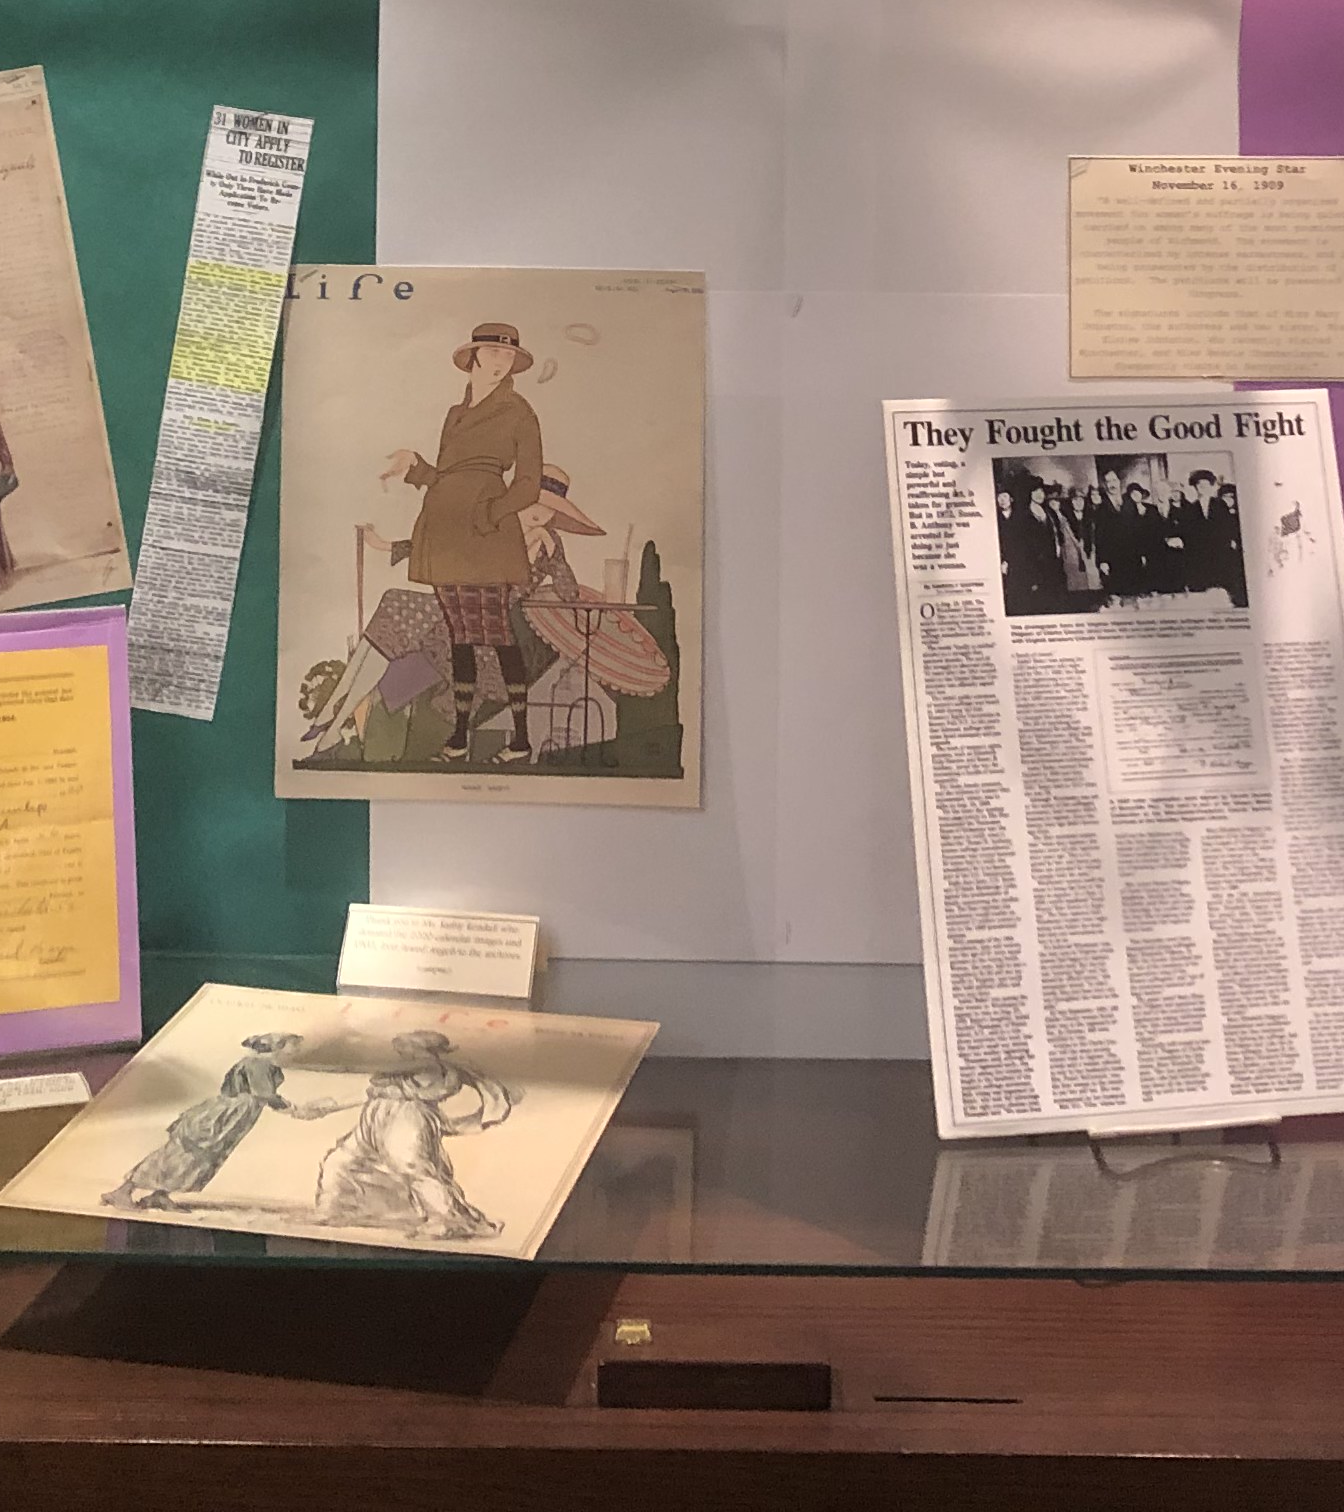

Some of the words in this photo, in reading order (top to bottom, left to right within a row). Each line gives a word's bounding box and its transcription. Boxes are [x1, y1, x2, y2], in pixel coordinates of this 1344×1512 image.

[214, 112, 226, 125] 31
[234, 114, 273, 132] WOMEN
[277, 120, 290, 135] IN
[226, 130, 251, 147] CITY
[255, 134, 290, 153] APPLY
[239, 150, 253, 164] TO
[254, 152, 305, 171] REGISTER
[1129, 164, 1206, 173] Winchester
[1214, 164, 1269, 175] Evening
[1276, 164, 1307, 174] Star
[903, 420, 974, 452] They
[986, 417, 1083, 450] Fought
[1095, 416, 1138, 441] the
[1149, 414, 1222, 440] Good
[1234, 411, 1306, 443] Fight
